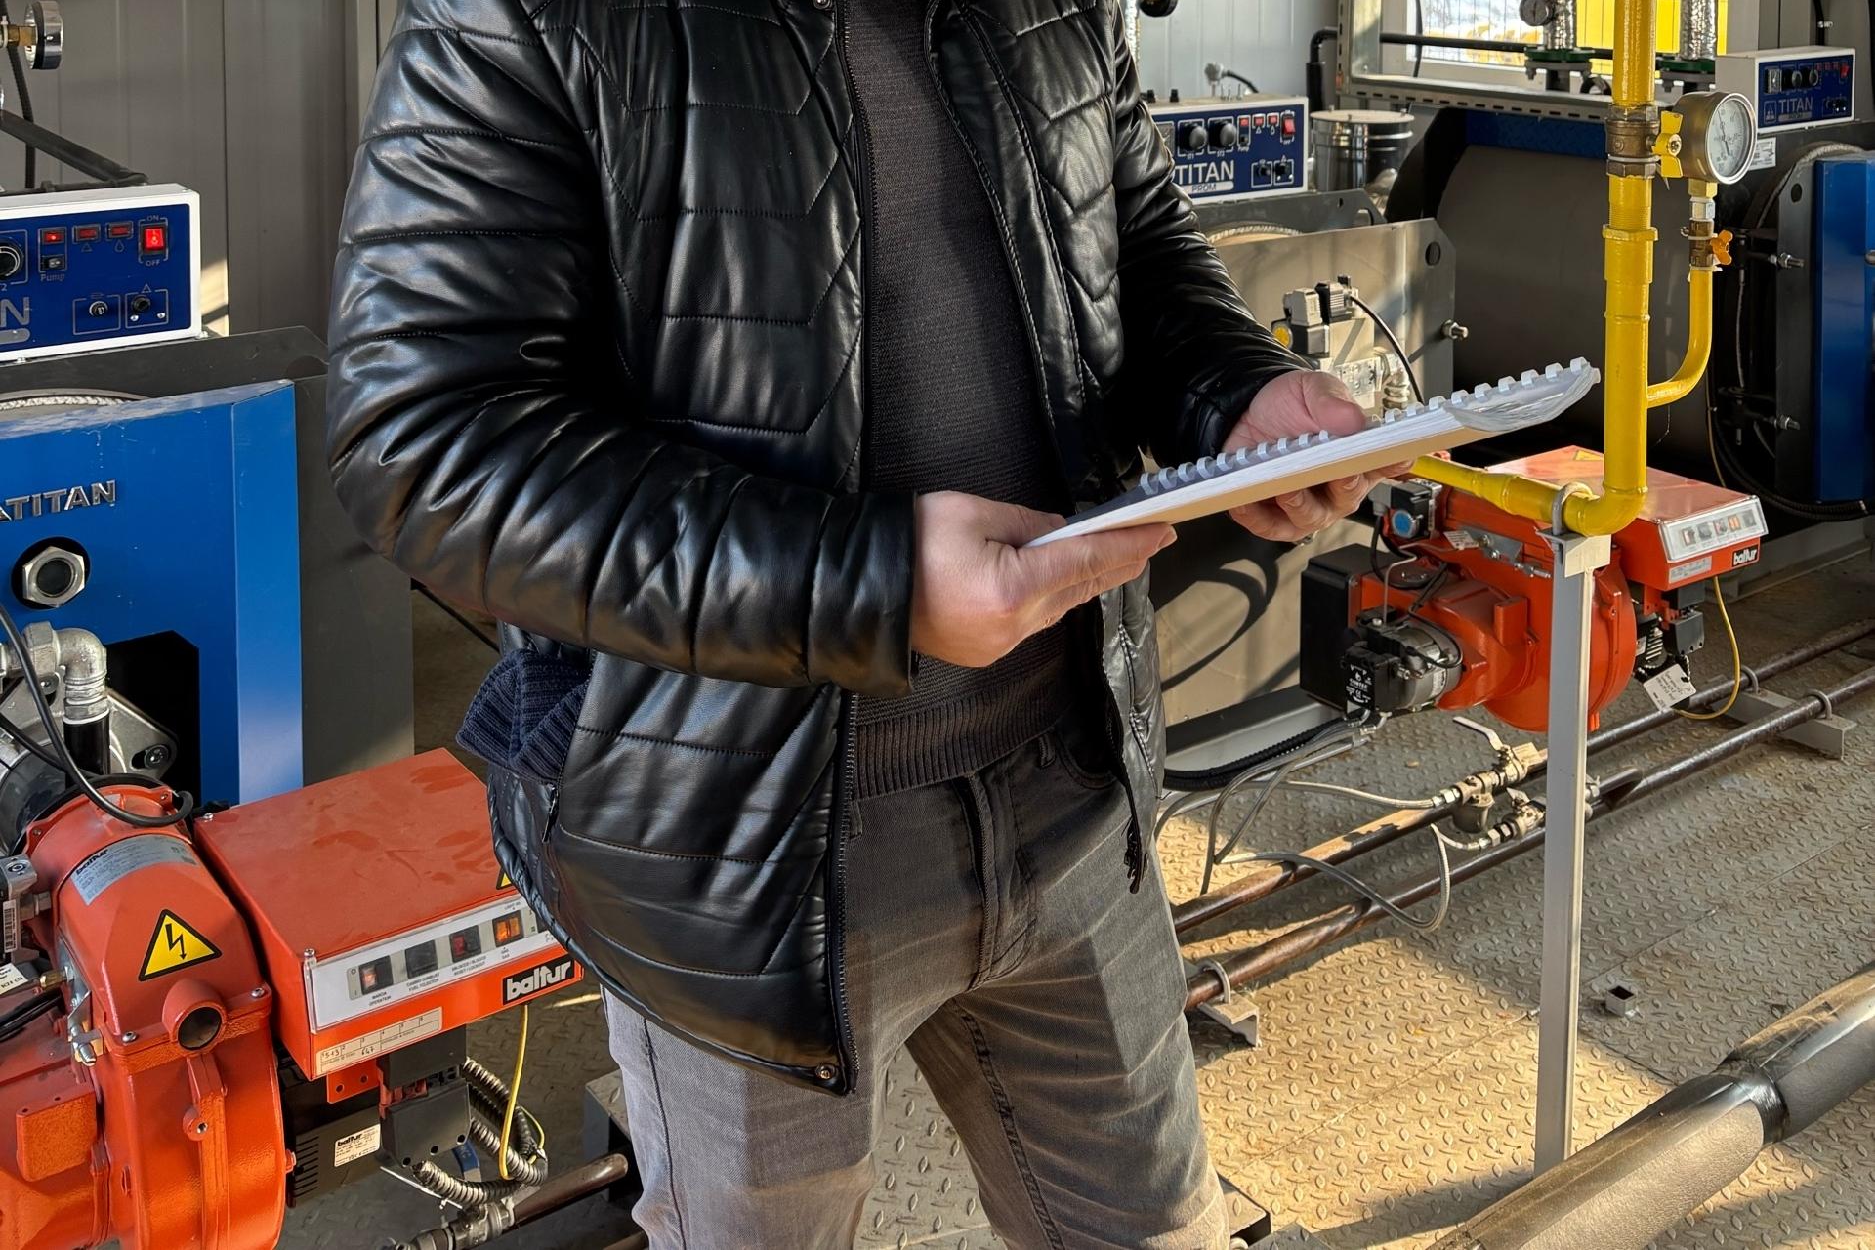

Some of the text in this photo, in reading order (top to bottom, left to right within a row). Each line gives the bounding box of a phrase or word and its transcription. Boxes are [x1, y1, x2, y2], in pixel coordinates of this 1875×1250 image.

[1779, 97, 1814, 114] TITAN
[1175, 160, 1234, 185] TITAN
[147, 214, 160, 222] ON
[145, 259, 161, 267] OFF
[40, 273, 65, 282] Pump
[1733, 549, 1758, 566] baltur
[507, 960, 571, 1001] baltur
